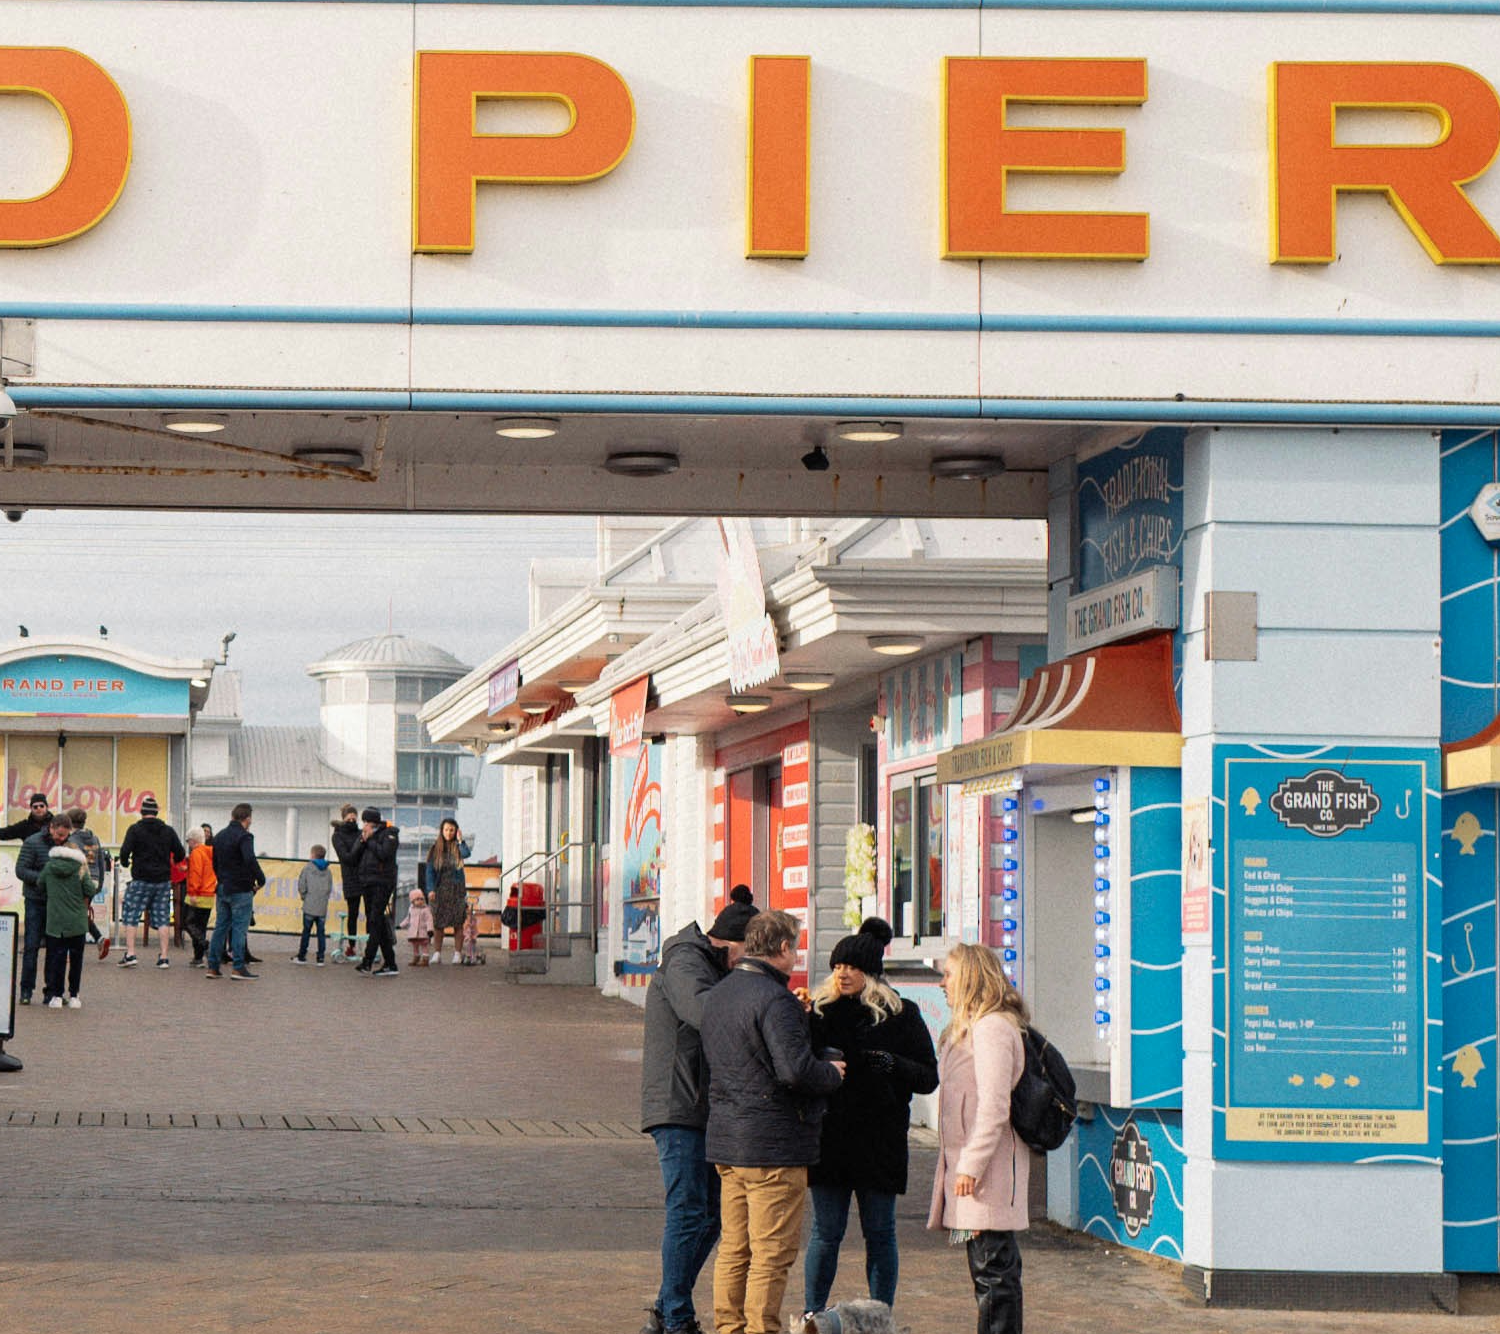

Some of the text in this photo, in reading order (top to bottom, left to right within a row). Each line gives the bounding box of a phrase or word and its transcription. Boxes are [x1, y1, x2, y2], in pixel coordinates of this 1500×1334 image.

[1103, 455, 1170, 524] TRADITIONAL
[1102, 515, 1173, 582] FISH & CHIPS
[1075, 586, 1144, 638] THE GRAND FISH CO.
[73, 680, 125, 691] PIER
[952, 749, 979, 773] TRADITIONAL
[980, 746, 992, 766] FISH
[1317, 780, 1335, 792] THE
[1283, 792, 1367, 810] GRAND FISH
[1320, 809, 1335, 821] CO.
[1263, 872, 1280, 881] Chips
[1276, 884, 1294, 893] Chips
[1276, 897, 1294, 906] Chips
[1276, 909, 1293, 918] Chips
[1127, 1141, 1137, 1160] THE
[1114, 1158, 1151, 1192] GRAND FISH
